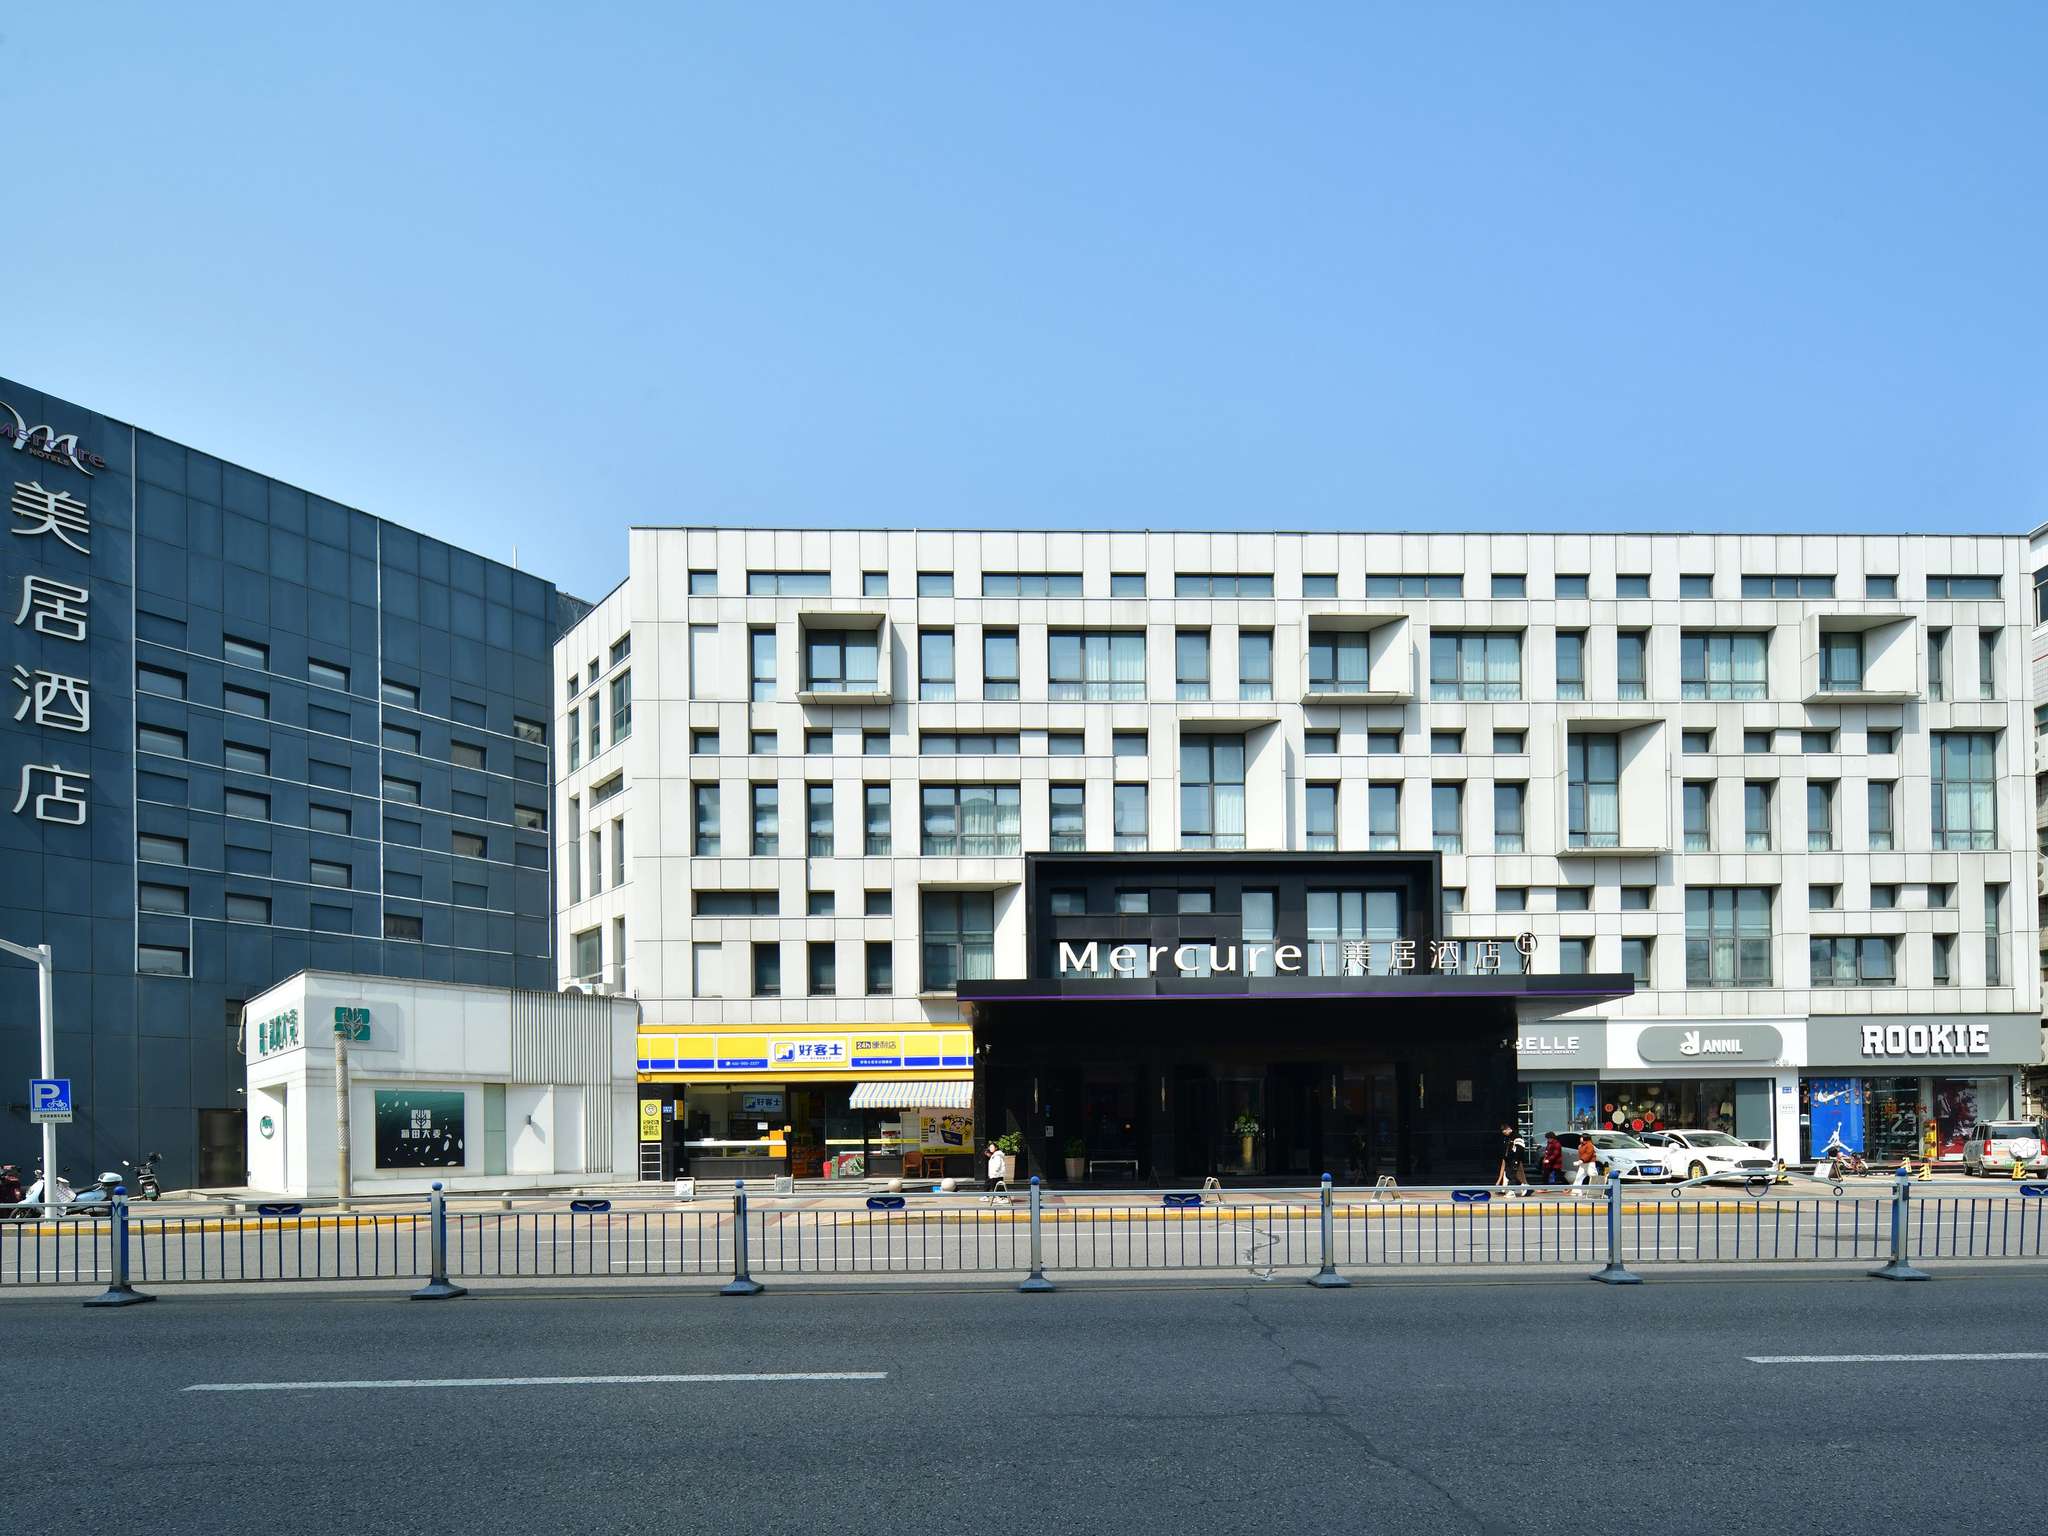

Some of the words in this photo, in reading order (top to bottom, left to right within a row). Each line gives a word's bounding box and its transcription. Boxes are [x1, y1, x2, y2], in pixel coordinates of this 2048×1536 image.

[29, 448, 71, 466] HOTELS
[11, 481, 91, 826] 美居酒店
[1059, 941, 1302, 973] Mercure
[1343, 940, 1503, 970] 美居酒店
[798, 1043, 843, 1056] 好客士
[1702, 1039, 1744, 1053] ANNIL
[1861, 1024, 1990, 1054] ROOKIE
[33, 1083, 60, 1108] P
